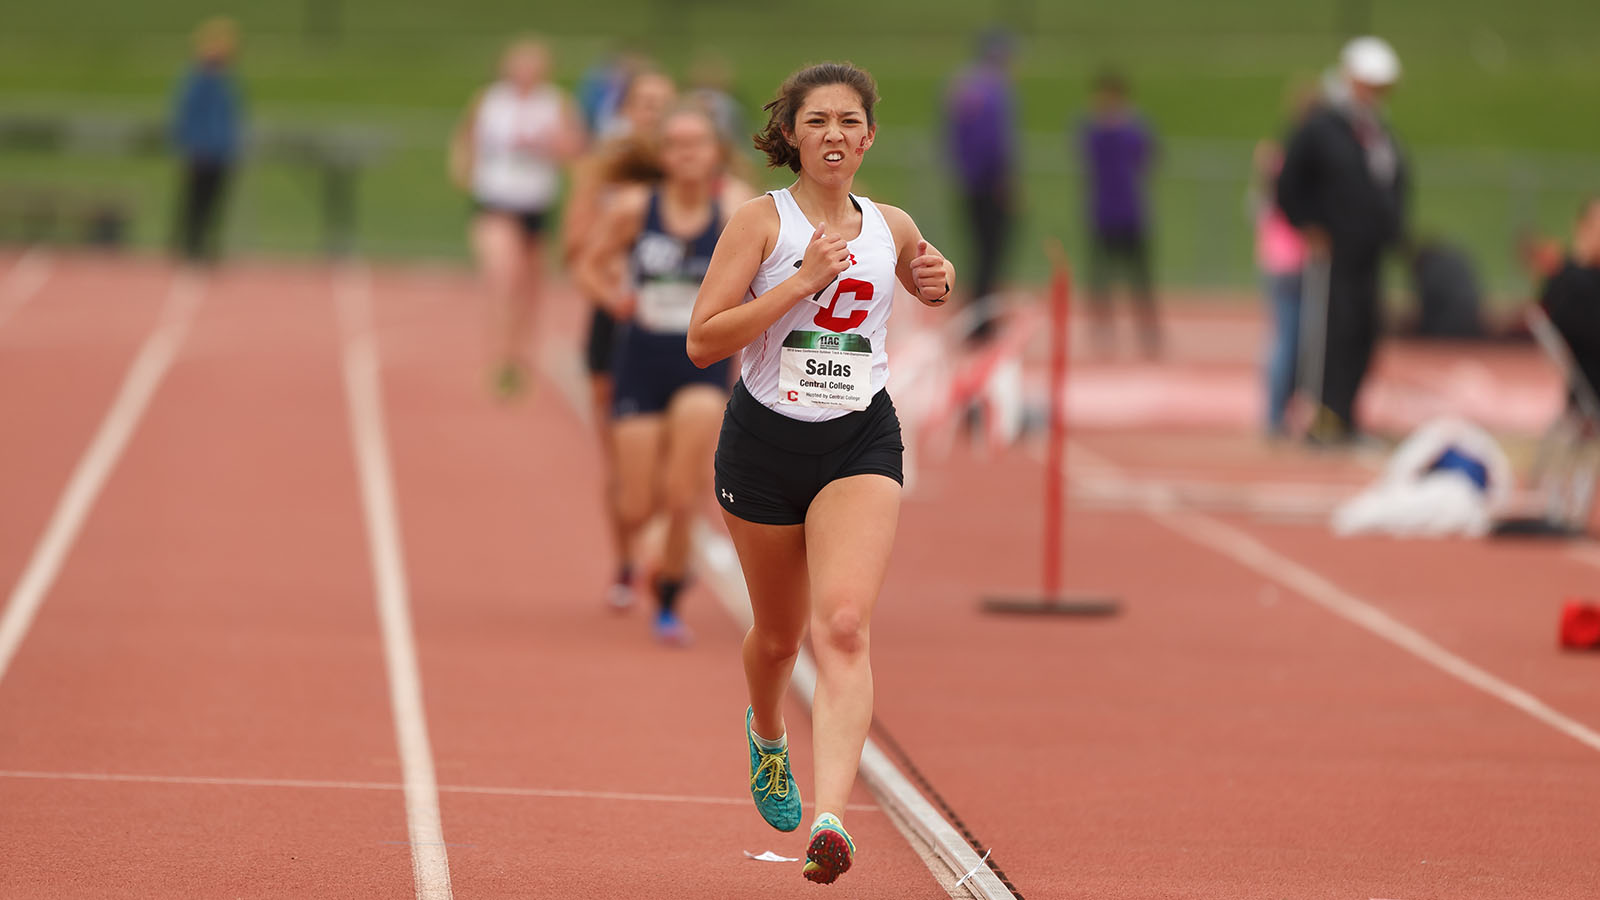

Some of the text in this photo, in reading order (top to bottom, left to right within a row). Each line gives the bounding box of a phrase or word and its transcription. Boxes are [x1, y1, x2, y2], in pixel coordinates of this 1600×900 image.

[813, 278, 874, 333] C
[805, 358, 851, 377] Salas
[799, 379, 855, 392] Central College
[787, 390, 799, 402] C
